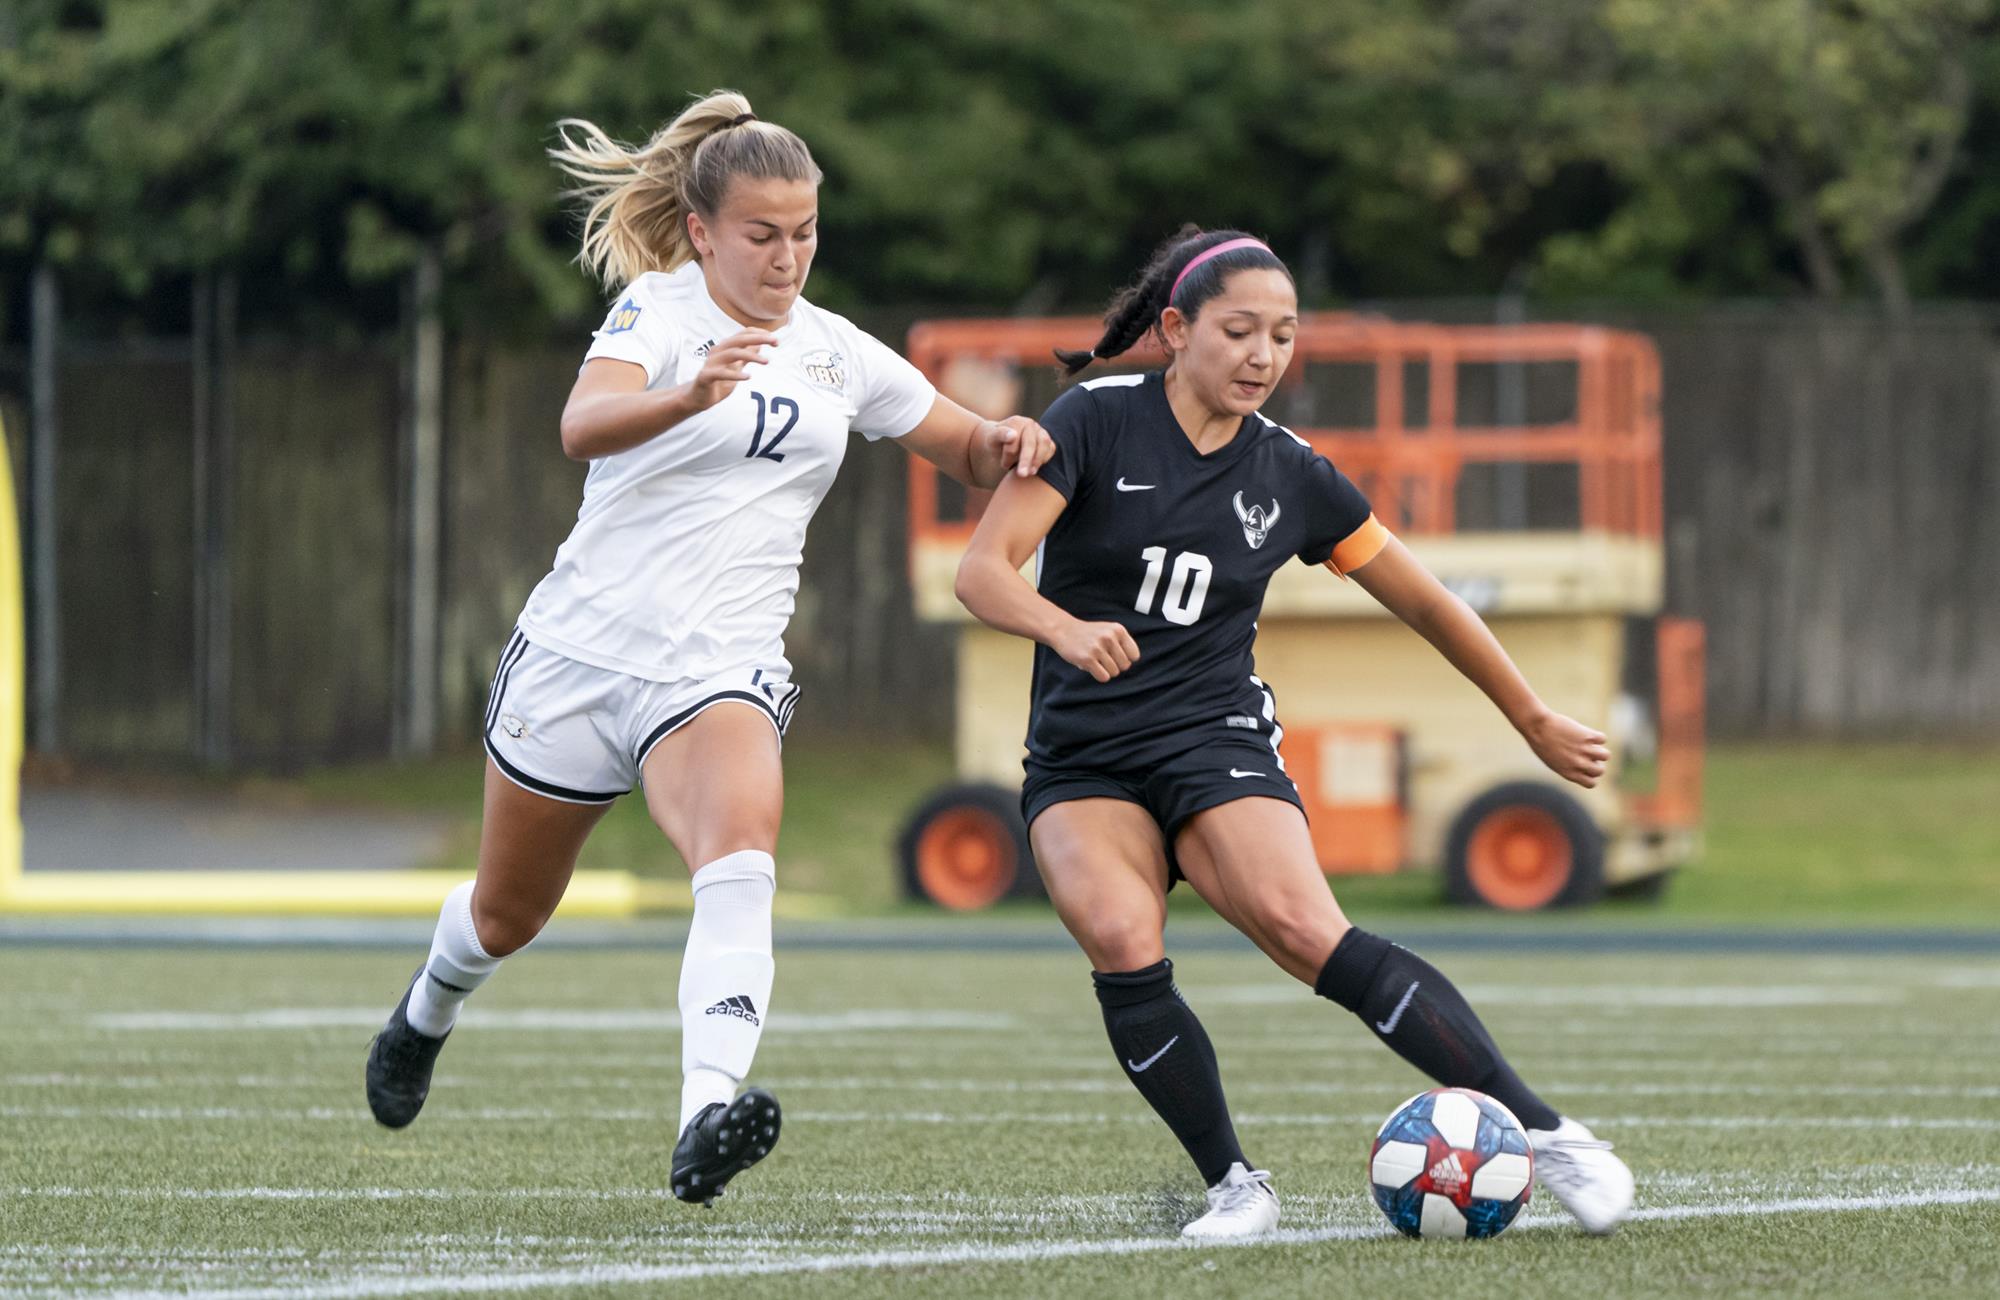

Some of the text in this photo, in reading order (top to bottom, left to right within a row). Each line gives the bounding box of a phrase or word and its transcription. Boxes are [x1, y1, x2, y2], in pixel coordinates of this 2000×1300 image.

[745, 391, 799, 463] 12
[1134, 546, 1213, 626] 10
[705, 1003, 759, 1027] adidas
